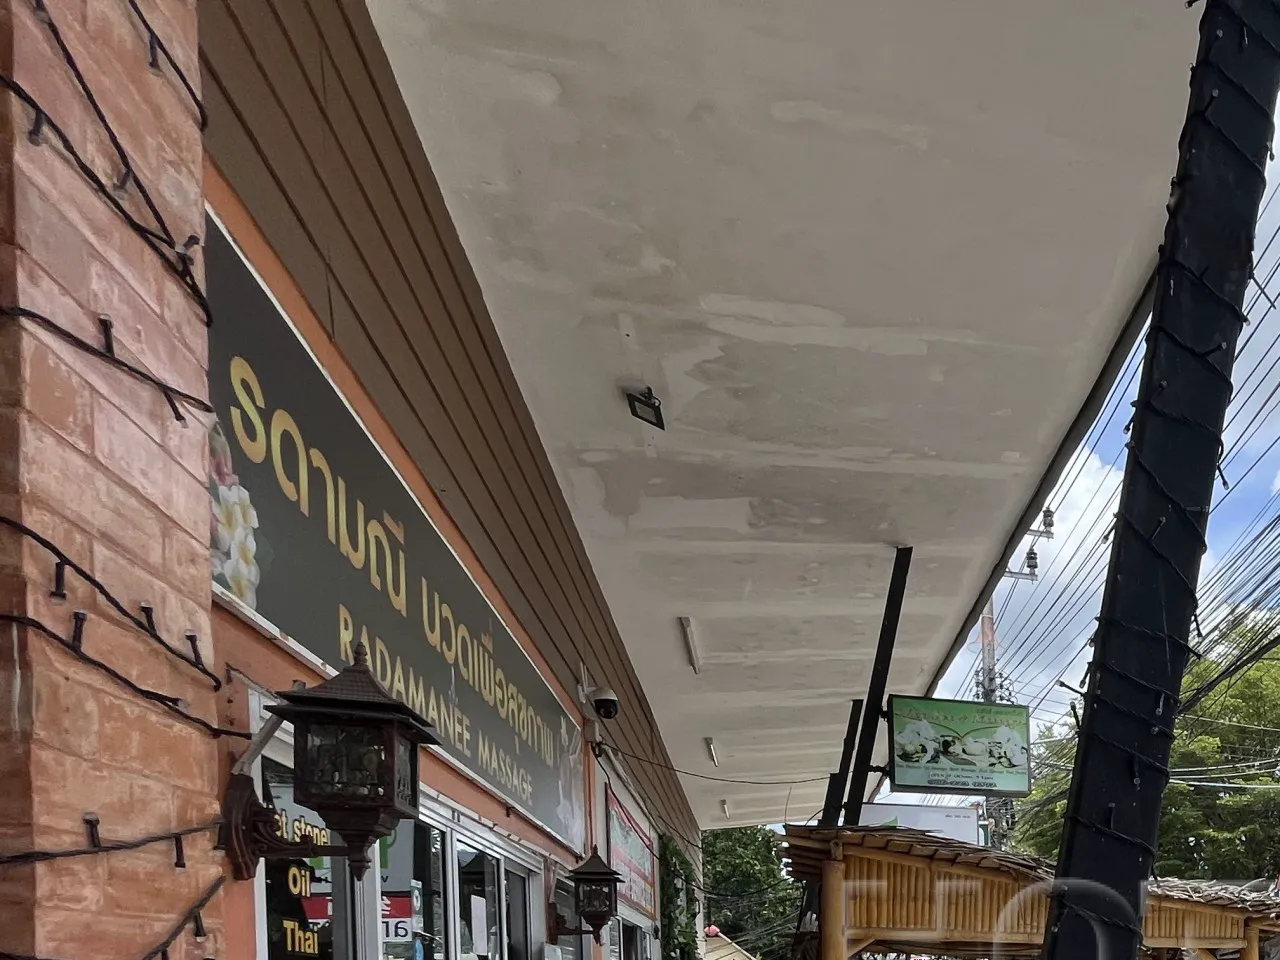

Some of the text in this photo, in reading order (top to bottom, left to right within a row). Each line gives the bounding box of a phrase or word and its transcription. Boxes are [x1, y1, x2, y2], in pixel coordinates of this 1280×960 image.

[338, 603, 534, 806] RADAMANEE MASSAGE
[288, 866, 312, 898] Oil
[282, 918, 319, 956] Thai
